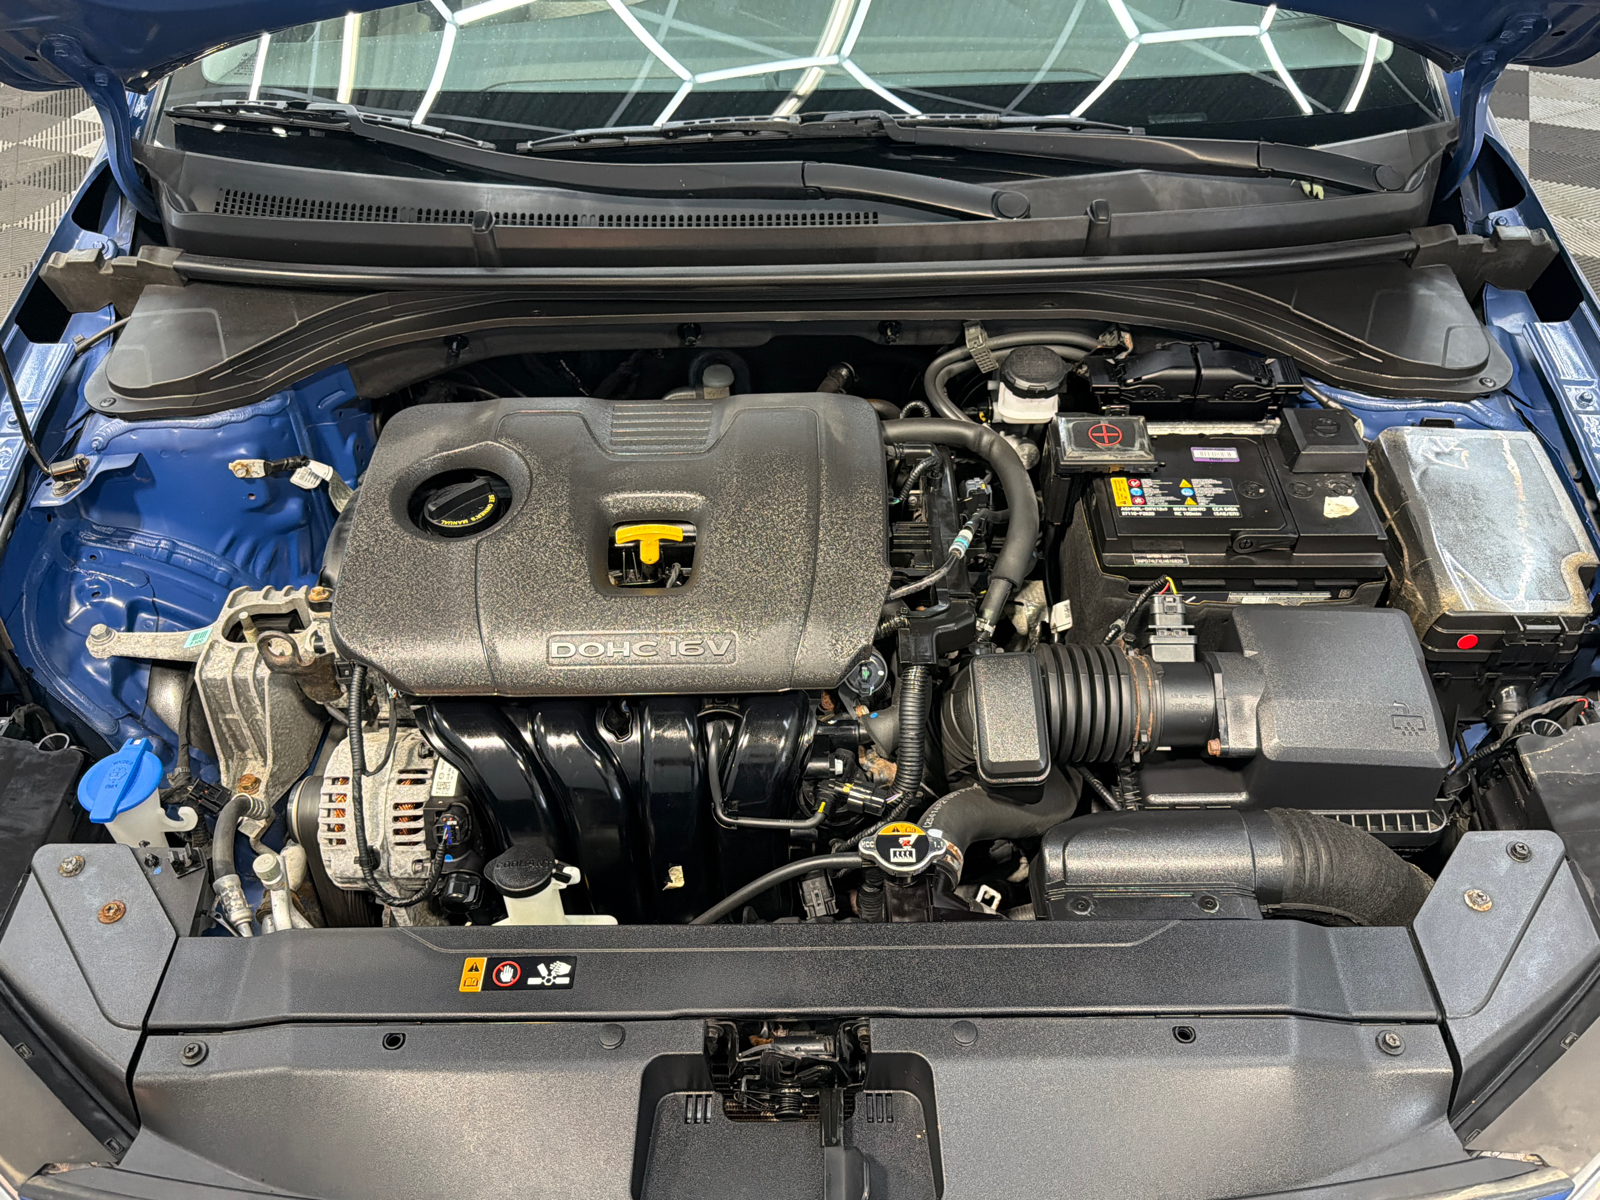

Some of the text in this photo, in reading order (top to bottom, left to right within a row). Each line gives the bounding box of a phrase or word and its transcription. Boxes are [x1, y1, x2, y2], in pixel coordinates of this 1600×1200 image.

[550, 639, 733, 658] DOHC 16V
[496, 859, 553, 870] COOLANT
